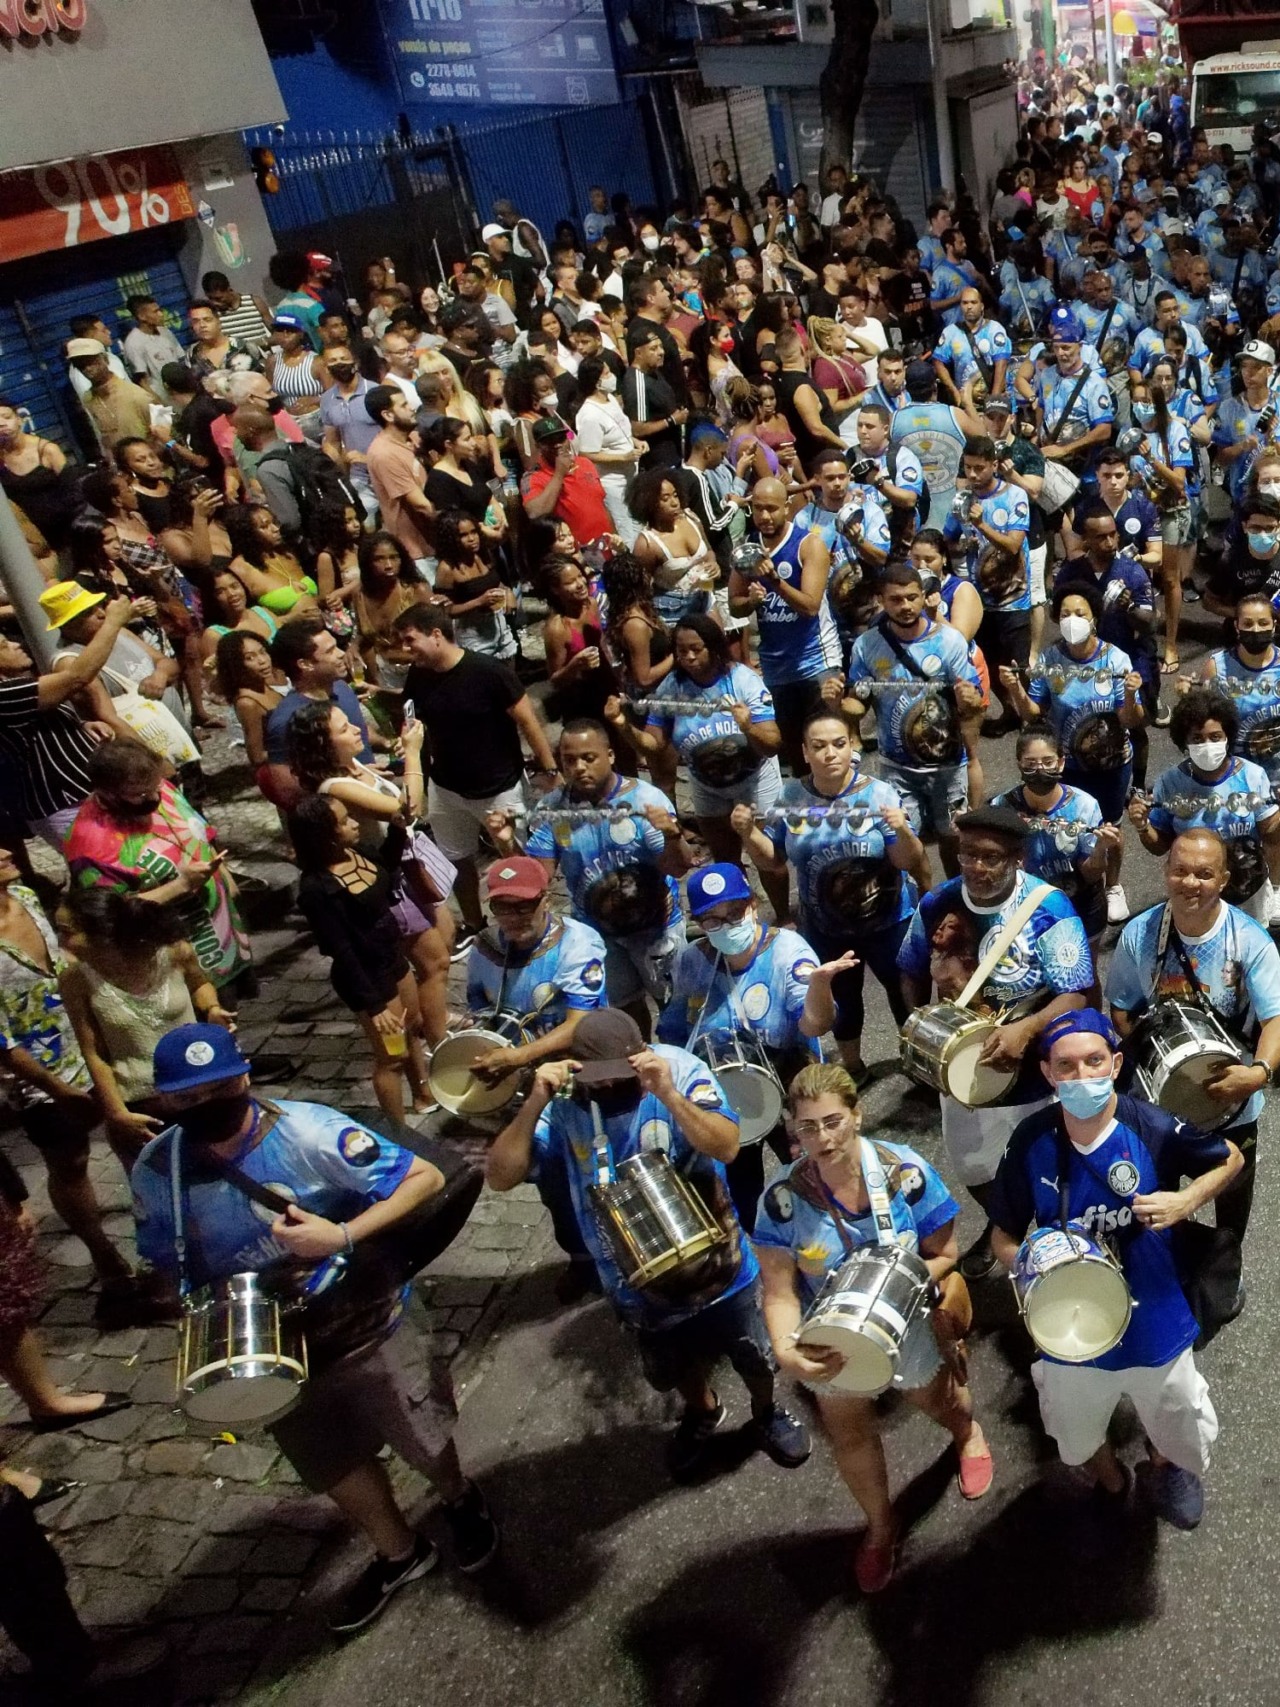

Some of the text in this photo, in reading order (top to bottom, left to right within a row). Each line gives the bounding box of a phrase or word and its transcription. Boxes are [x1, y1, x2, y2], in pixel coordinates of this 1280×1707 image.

[1255, 706, 1270, 721] DE
[699, 723, 714, 740] DE
[822, 843, 842, 862] DE
[841, 842, 872, 858] NOEL
